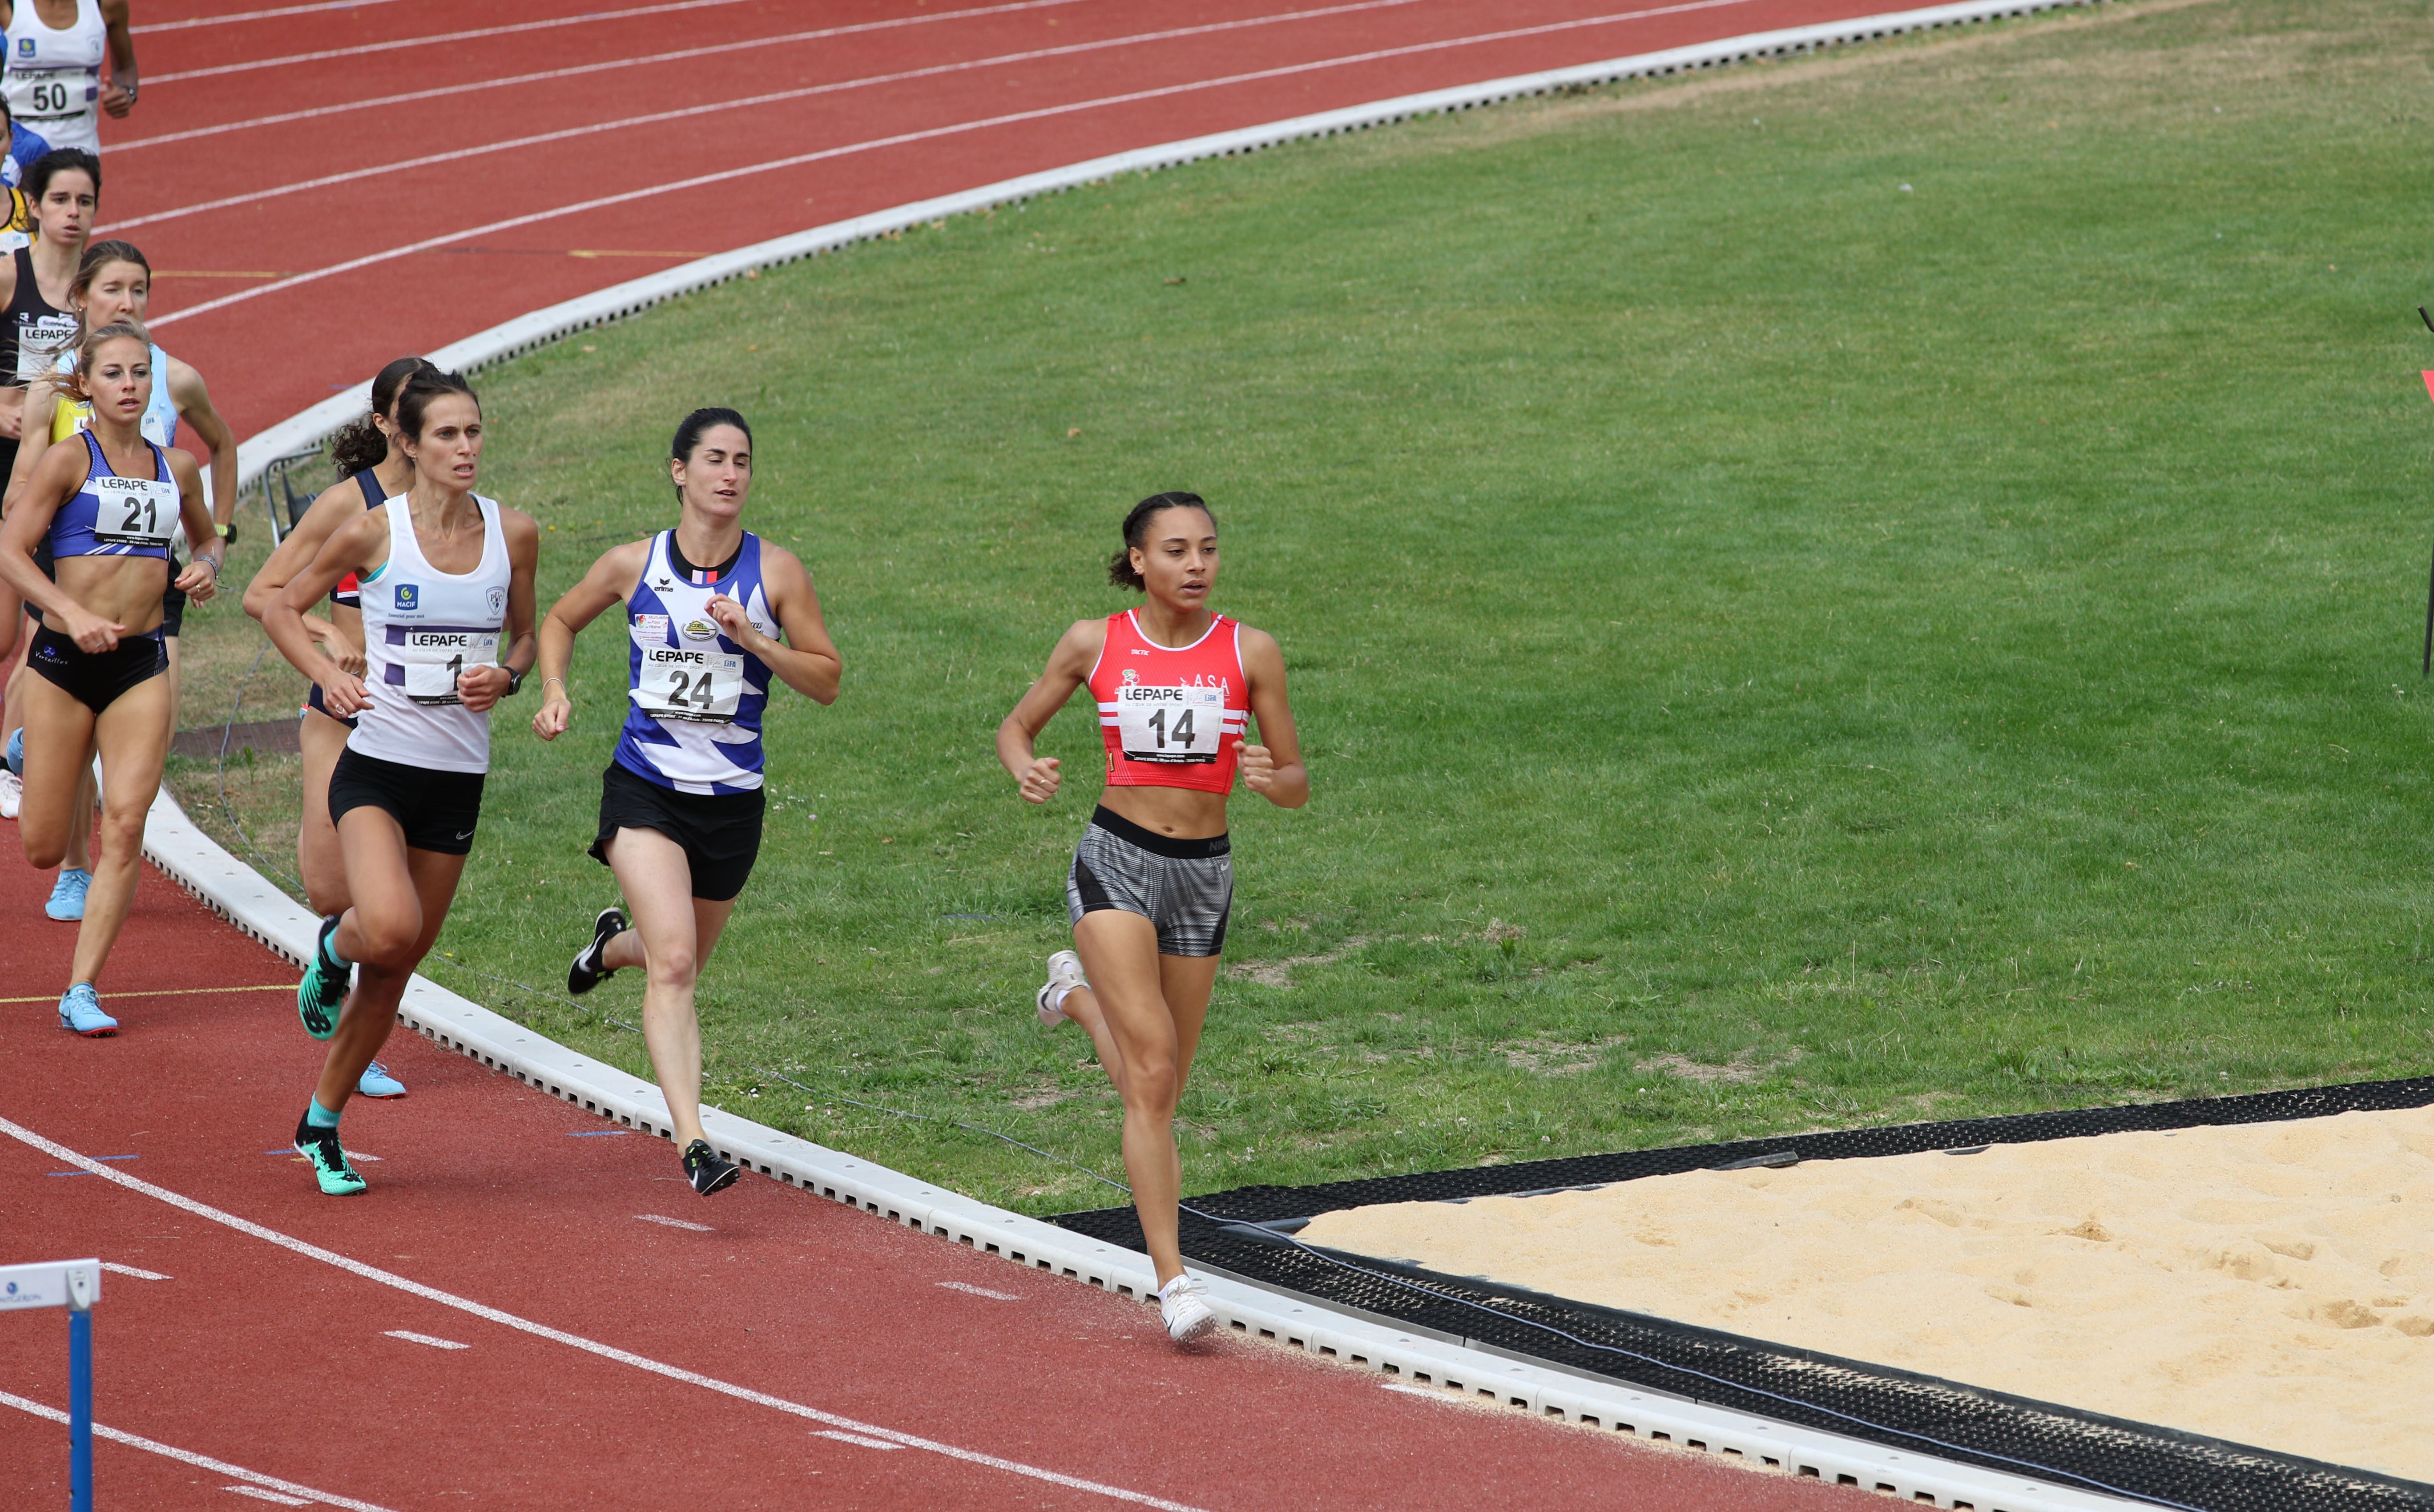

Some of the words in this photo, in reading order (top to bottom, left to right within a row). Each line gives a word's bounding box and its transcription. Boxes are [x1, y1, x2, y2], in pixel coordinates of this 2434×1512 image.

[34, 84, 66, 111] 50
[102, 479, 148, 491] LEPAPE
[121, 497, 156, 533] 21
[491, 592, 502, 602] PUC
[412, 635, 467, 647] LEPAPE
[36, 651, 68, 665] Versailles
[649, 649, 704, 664] LEPAPE
[724, 660, 736, 668] LiFA
[447, 654, 462, 690] 1
[668, 670, 713, 710] 24
[1126, 689, 1183, 701] LEPAPE
[1149, 709, 1195, 749] 14
